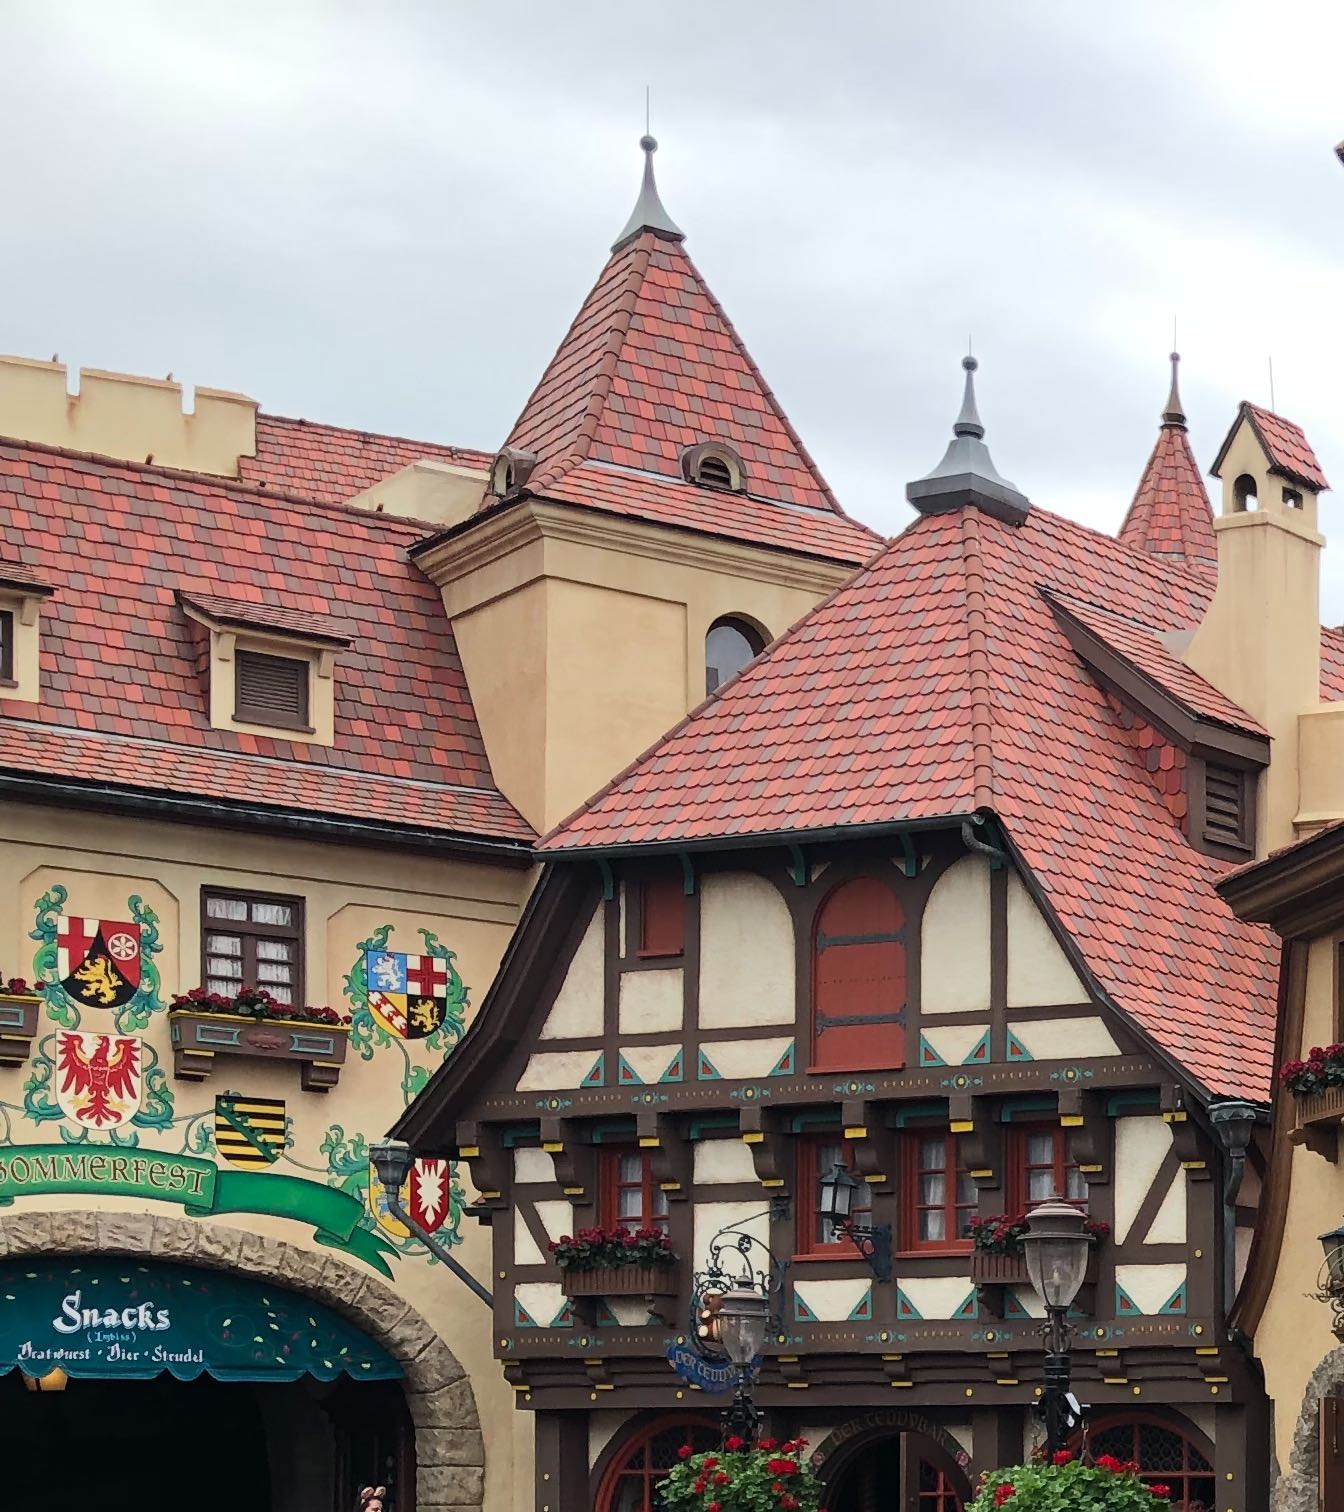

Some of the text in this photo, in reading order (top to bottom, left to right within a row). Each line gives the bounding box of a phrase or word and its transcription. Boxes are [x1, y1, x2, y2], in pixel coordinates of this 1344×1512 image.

[52, 1290, 171, 1334] Snacks
[17, 1340, 204, 1363] Bratwurst Bier Strudel
